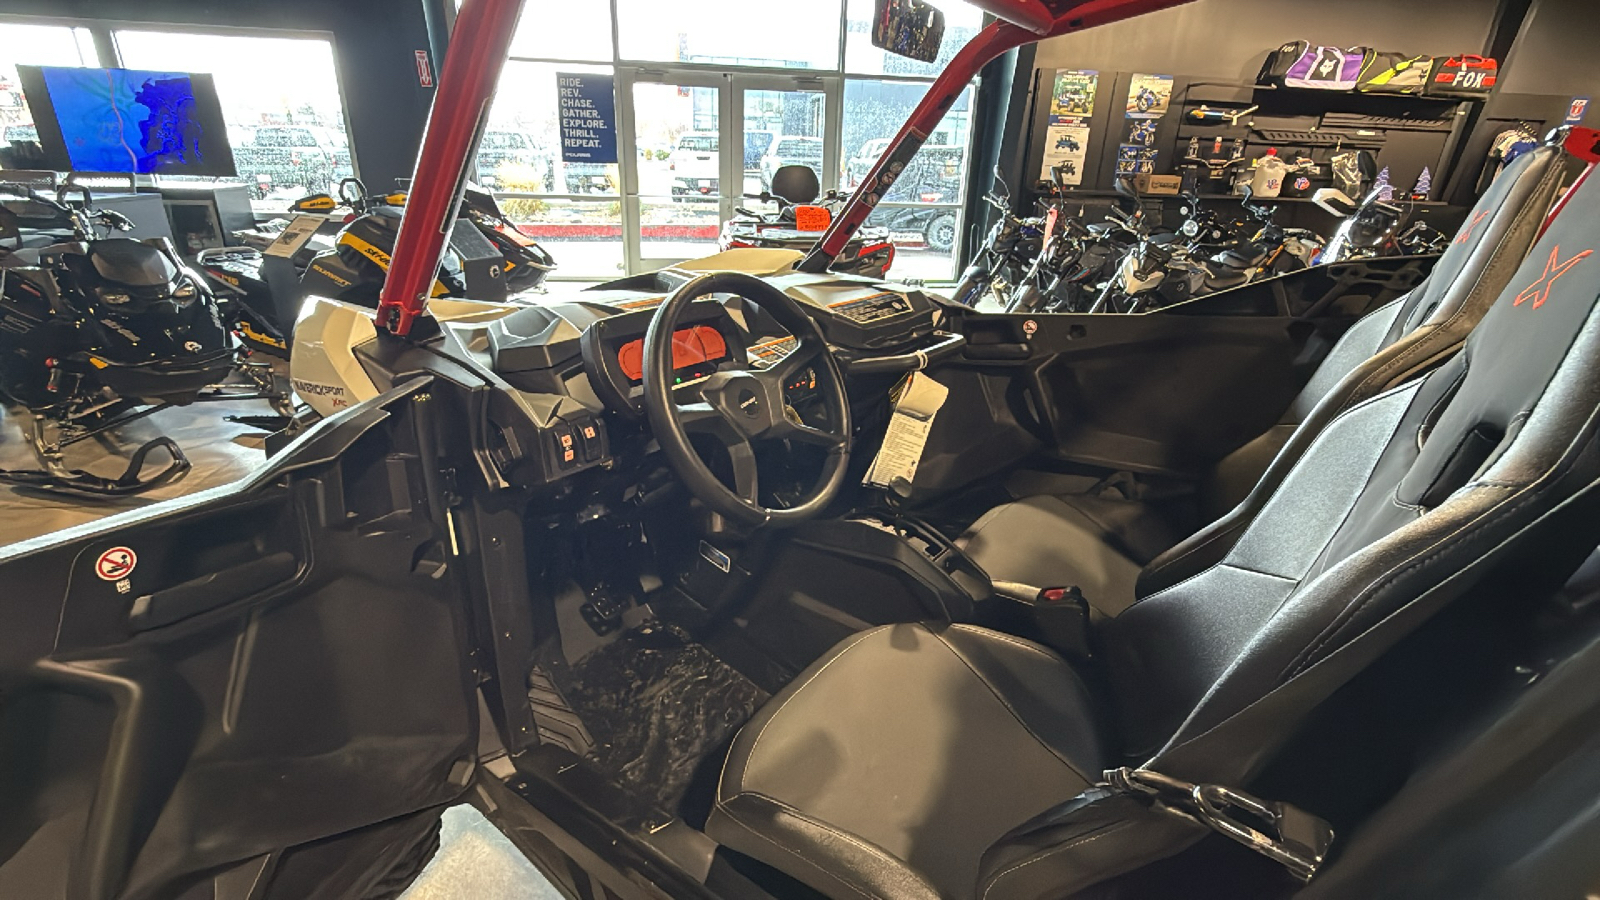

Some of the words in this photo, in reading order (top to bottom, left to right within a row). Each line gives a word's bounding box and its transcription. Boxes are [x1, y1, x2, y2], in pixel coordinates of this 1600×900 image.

[560, 77, 584, 88] RIDE.
[1452, 71, 1486, 88] FOX
[560, 88, 582, 98] REV.
[561, 98, 595, 108] CHASE.
[562, 108, 601, 119] GATHER.
[563, 118, 608, 129] EXPLORE.
[563, 128, 599, 138] THRILL.
[564, 138, 602, 148] REPEAT.
